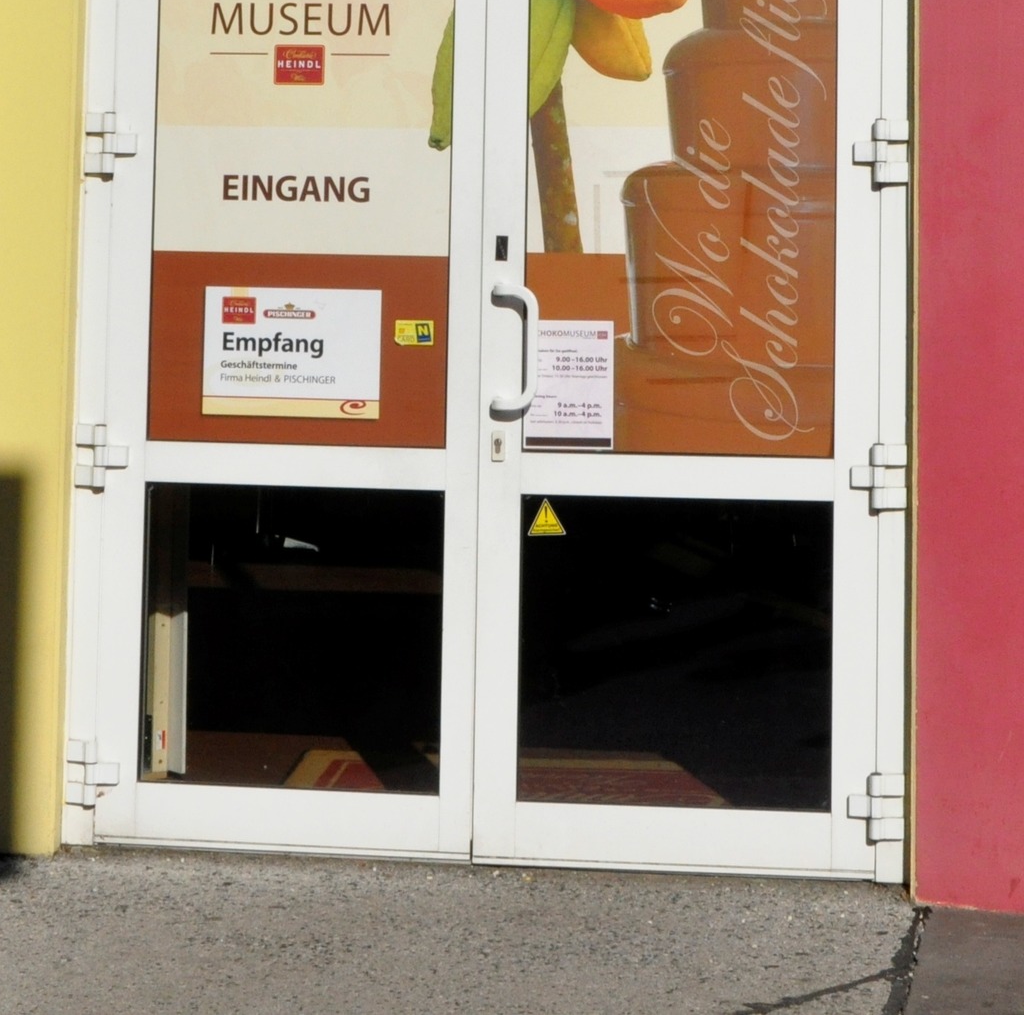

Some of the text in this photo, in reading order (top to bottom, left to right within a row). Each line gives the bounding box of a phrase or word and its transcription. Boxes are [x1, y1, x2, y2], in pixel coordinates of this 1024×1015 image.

[210, 2, 391, 37] MUSEUM
[277, 59, 322, 69] HEINDL
[222, 174, 371, 203] EINGANG
[645, 117, 734, 356] Wo die
[720, 75, 815, 442] Schokolade
[224, 306, 254, 314] HEINDL
[267, 310, 312, 318] PISCHINGER
[538, 329, 597, 338] HOKOMUSEUM
[222, 331, 324, 359] Empfang
[220, 359, 298, 371] Geschäftstermine
[219, 373, 336, 384] Firma Heindl & PISCHINGER
